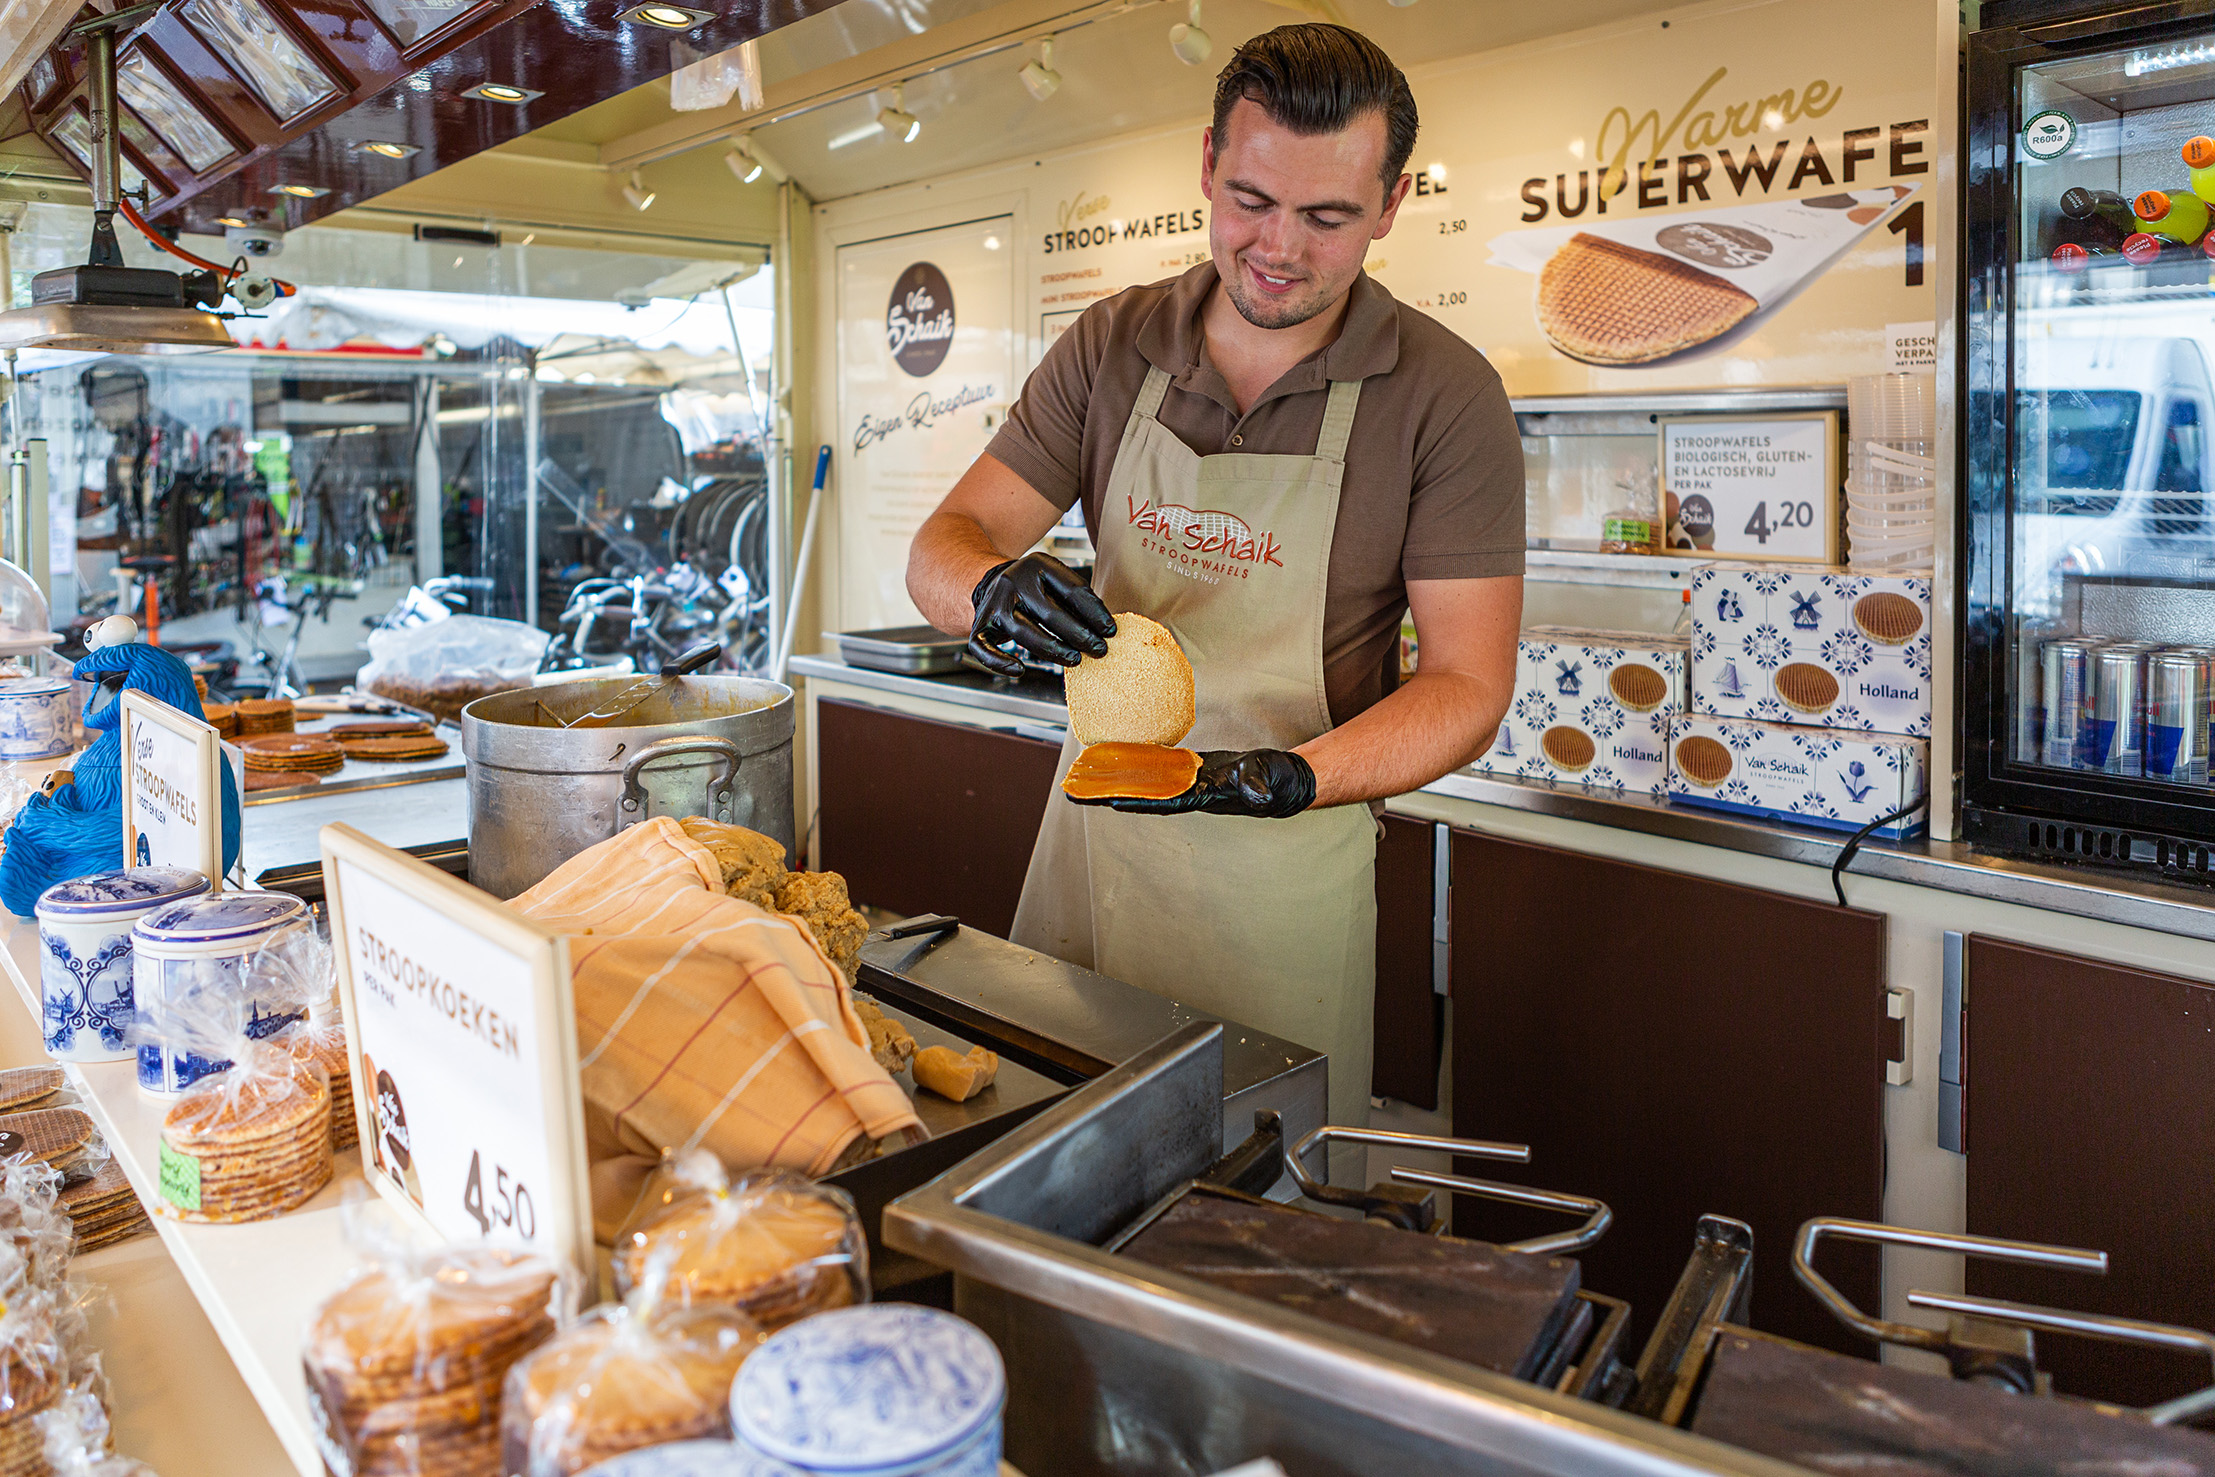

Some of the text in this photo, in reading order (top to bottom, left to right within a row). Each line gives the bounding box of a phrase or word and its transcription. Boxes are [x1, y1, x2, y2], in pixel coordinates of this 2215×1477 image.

[1595, 66, 1844, 200] Warme
[2032, 134, 2063, 144] R600a
[1520, 118, 1930, 223] SUPERWAFE
[1043, 209, 1204, 254] STROOPWAFELS
[1439, 219, 1467, 235] 2,50
[2129, 242, 2151, 255] Please
[905, 286, 935, 313] Van
[1438, 291, 1467, 308] 2,00
[887, 308, 954, 358] Schaik
[854, 391, 996, 458] Eigen Receptuur
[1674, 436, 1772, 448] STROOPWAFELS
[1674, 451, 1813, 464] BIOLOGISCH, GLUTEN-
[1674, 466, 1776, 477] EN LACTOSEVRIJ
[1674, 480, 1713, 490] PER PAK
[1127, 493, 1284, 568] Van Schaik
[1743, 500, 1814, 545] 4,20
[1141, 537, 1250, 579] STROOPWAFELS
[1166, 561, 1198, 580] SINDS
[1859, 683, 1919, 701] Holland
[130, 720, 154, 777] Verse
[1613, 745, 1663, 764] Holland
[1744, 756, 1810, 777] Van Schaik
[1749, 771, 1804, 785] STROOPWAFELS
[135, 762, 197, 827] STROOPWAFELS
[359, 926, 520, 1062] STROOPKOEKEN
[464, 1149, 535, 1240] 4,50
